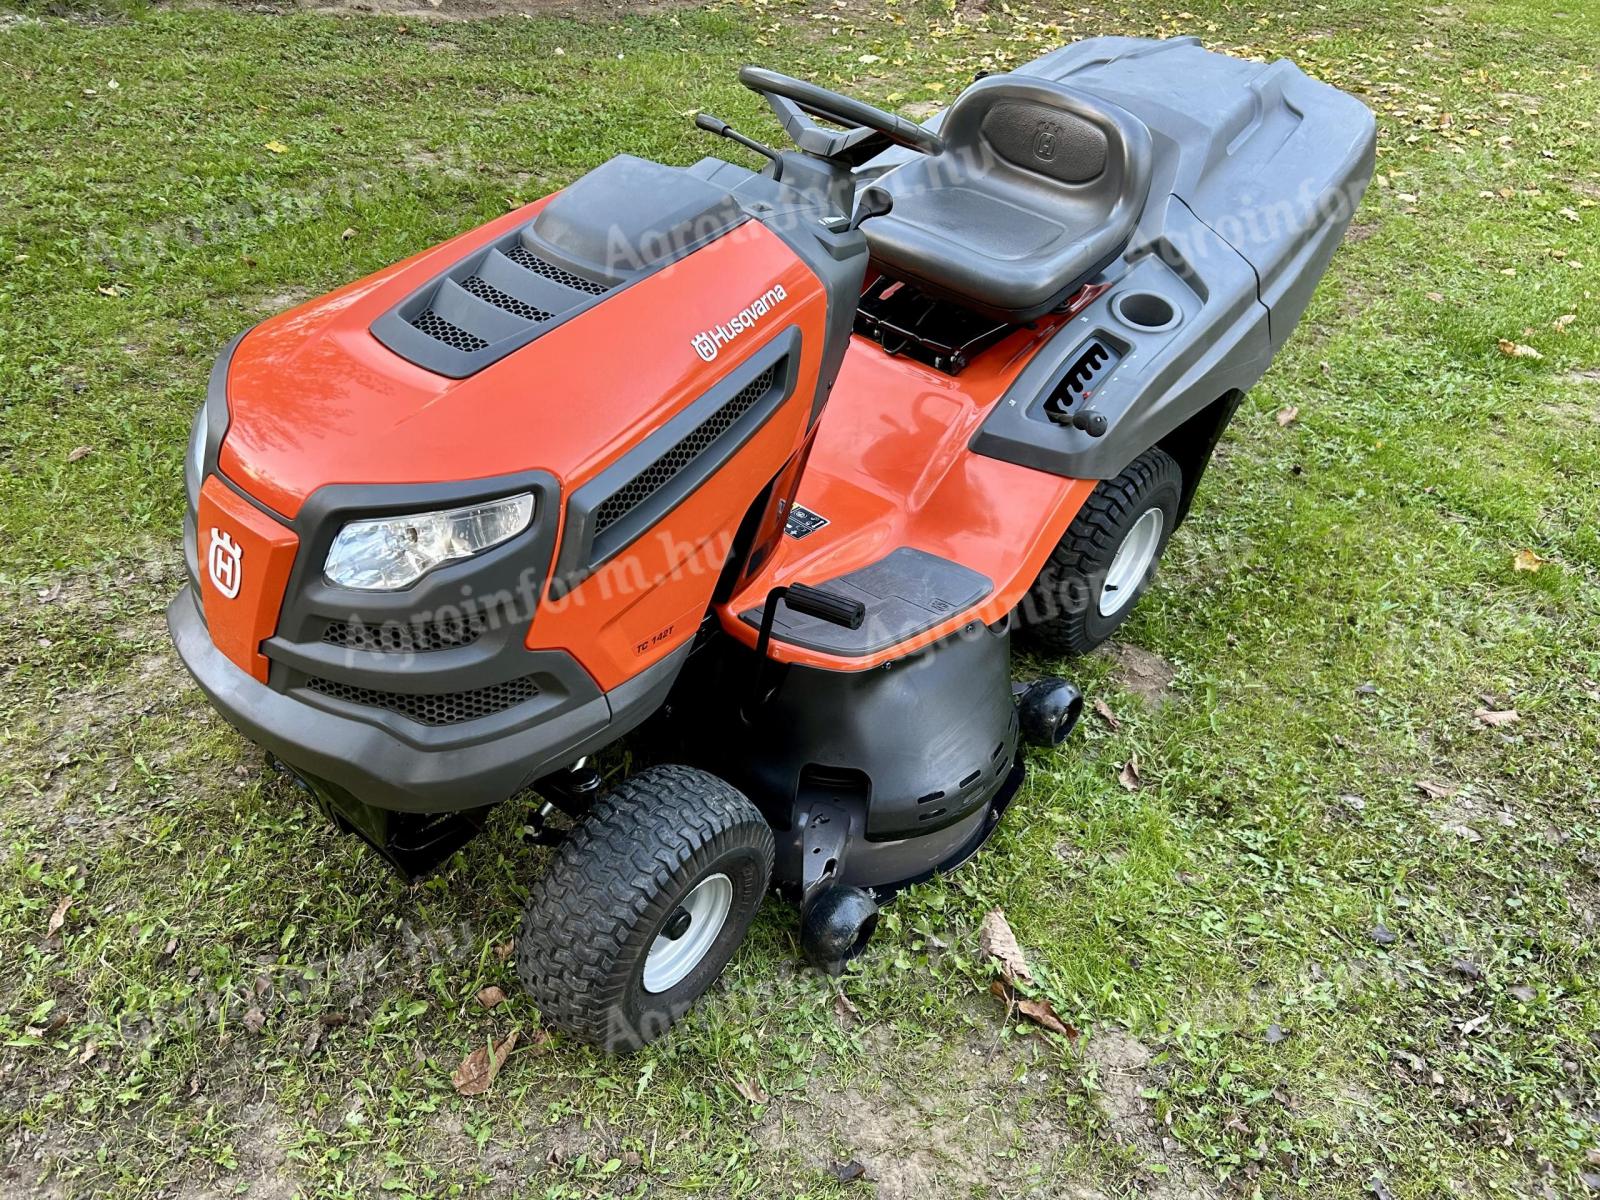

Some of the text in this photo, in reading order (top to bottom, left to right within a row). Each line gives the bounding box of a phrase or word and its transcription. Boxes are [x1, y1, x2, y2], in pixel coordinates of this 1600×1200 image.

[708, 284, 788, 349] Husqvarna
[637, 625, 674, 654] TC 142T
